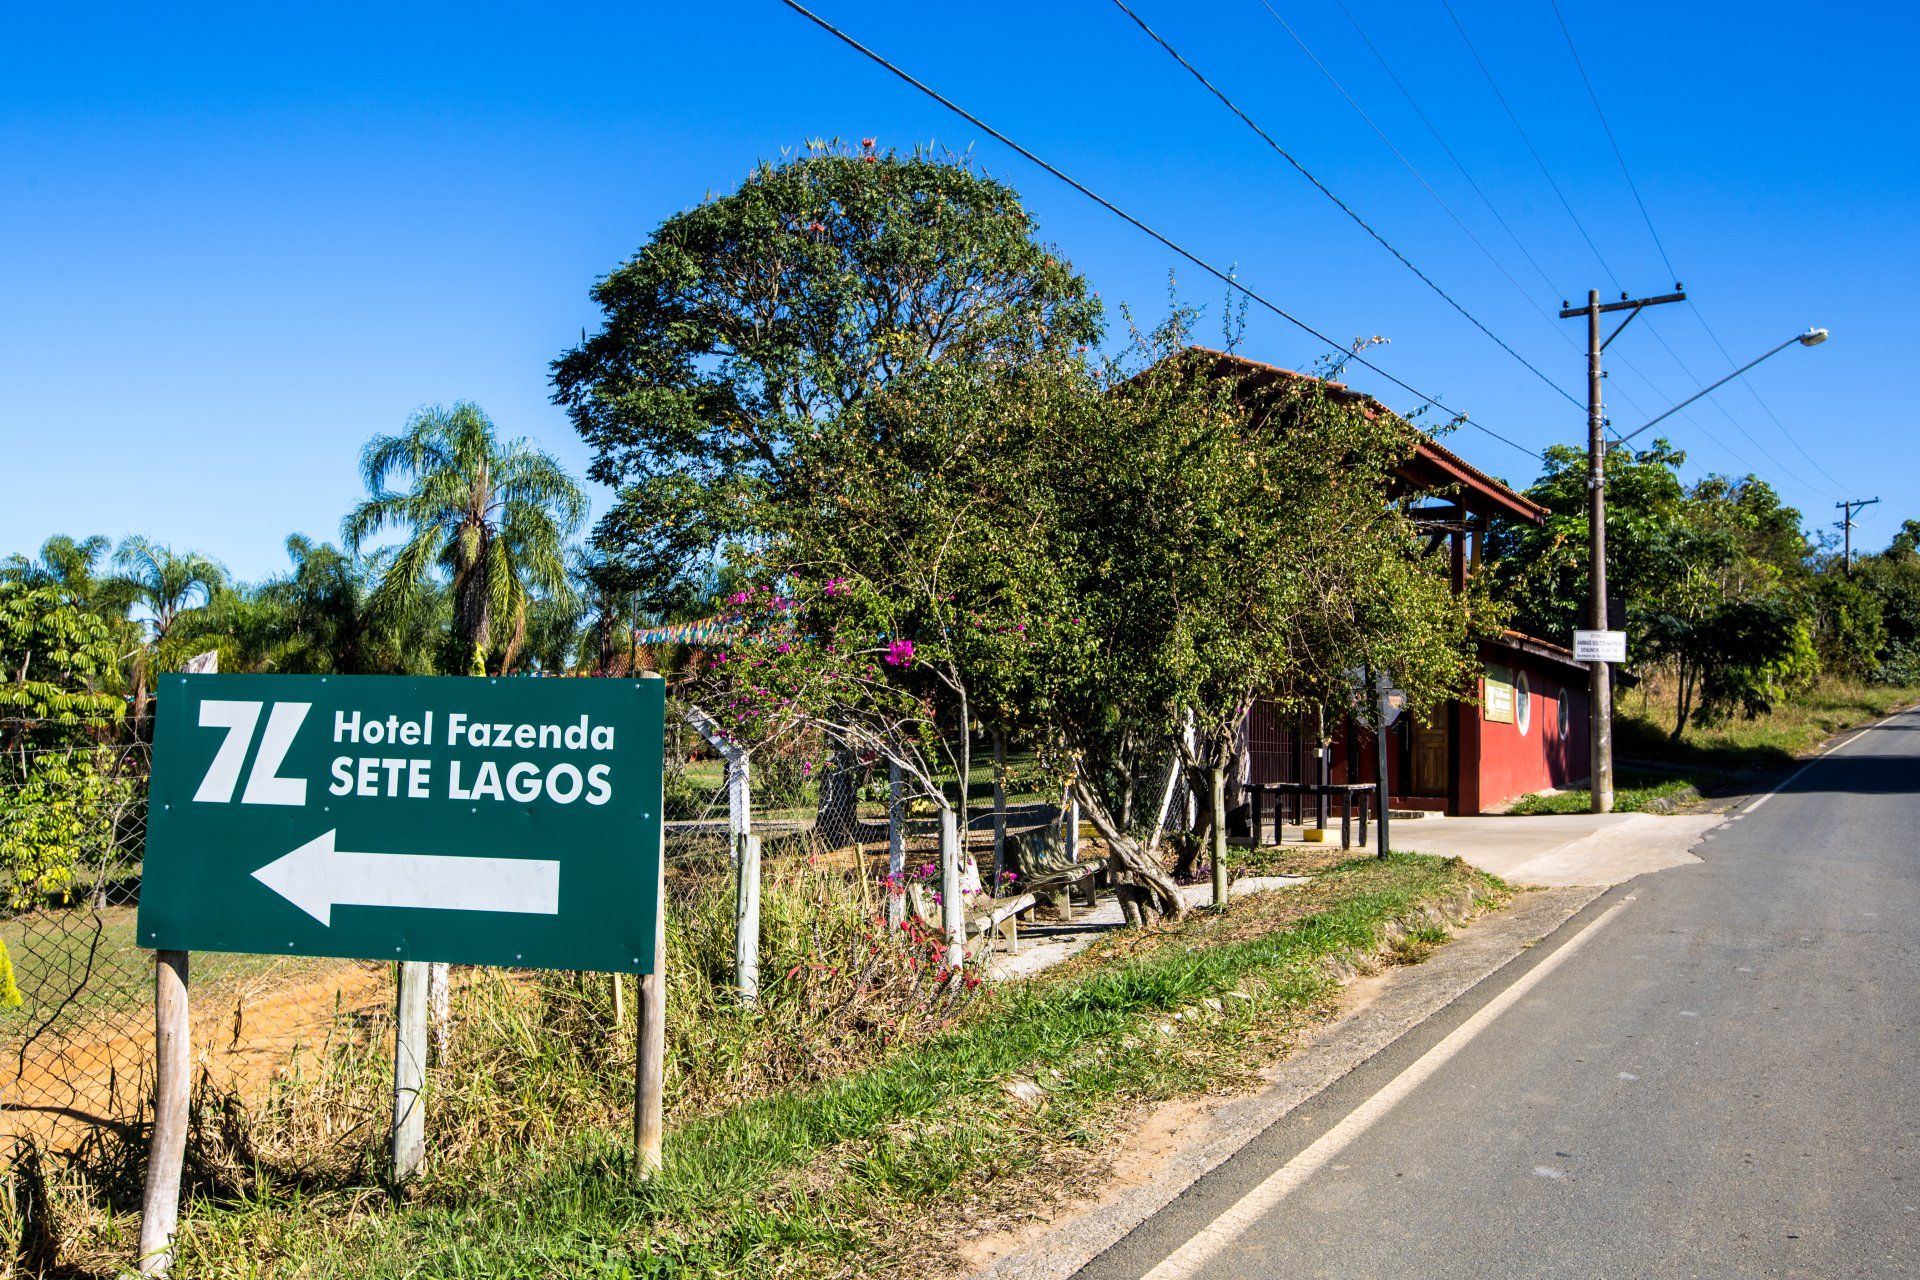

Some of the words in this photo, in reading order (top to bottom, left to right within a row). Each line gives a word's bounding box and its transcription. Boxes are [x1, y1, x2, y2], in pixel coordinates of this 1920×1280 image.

[333, 710, 433, 746] Hotel
[447, 713, 615, 751] Fazenda
[328, 756, 431, 799] SETE
[448, 760, 612, 807] LAGOS
